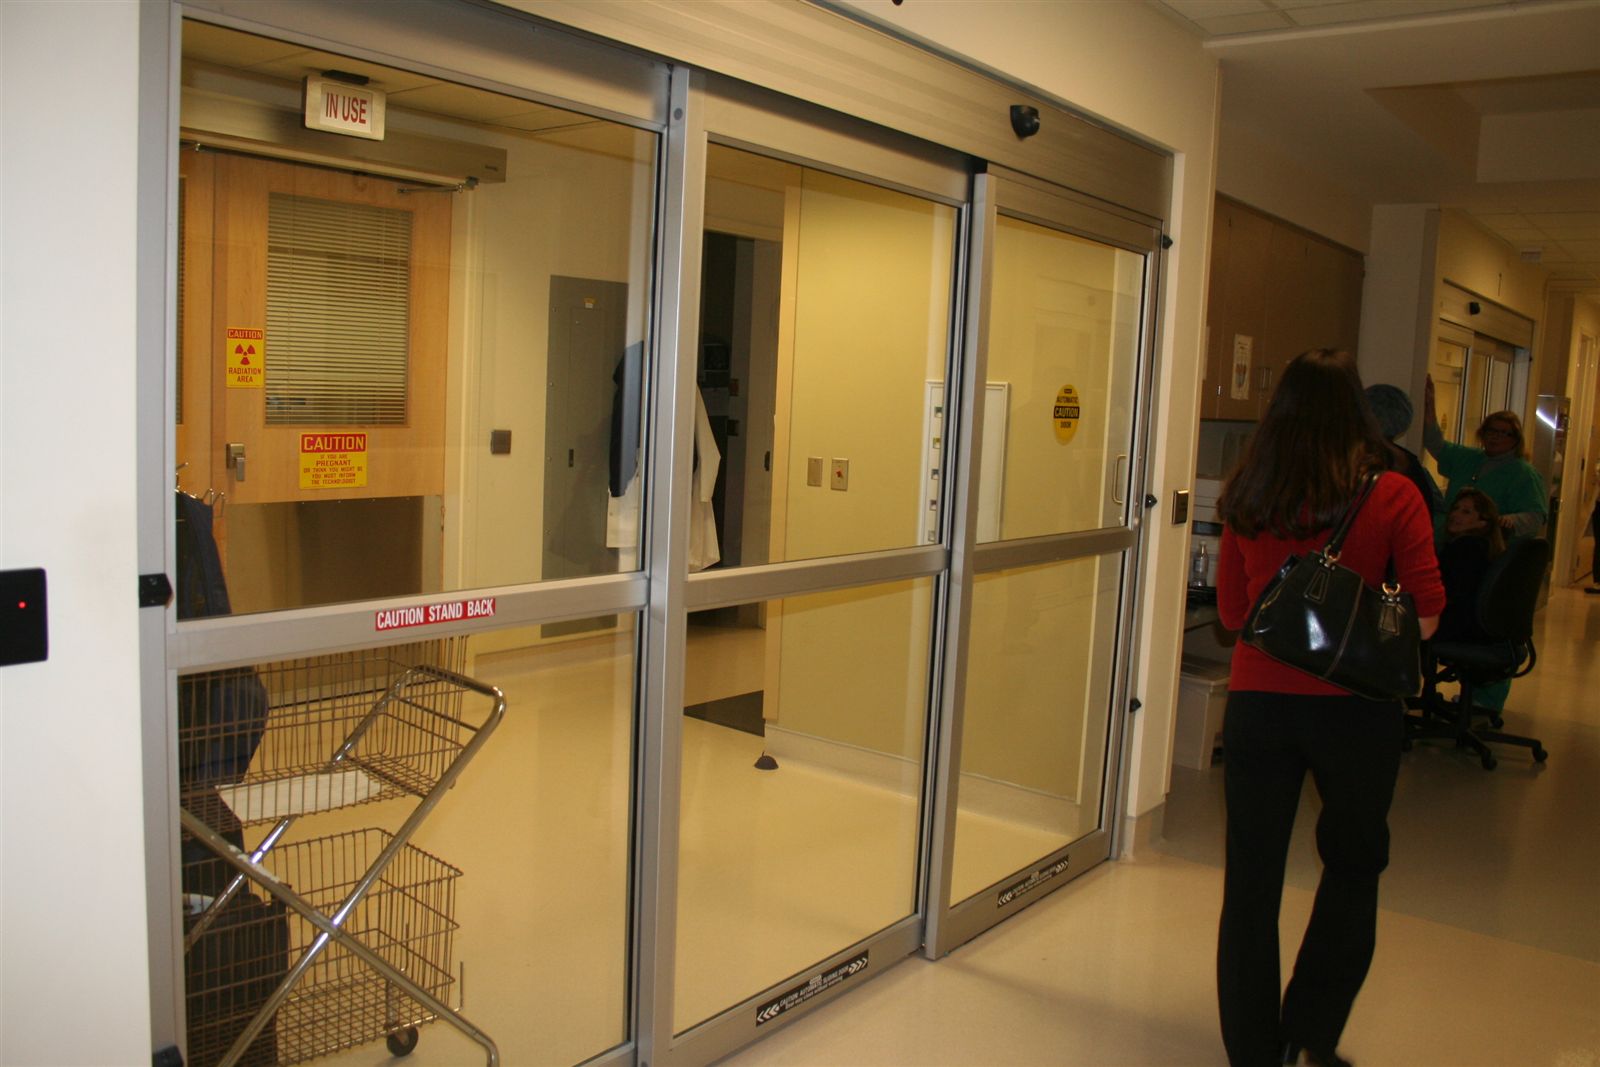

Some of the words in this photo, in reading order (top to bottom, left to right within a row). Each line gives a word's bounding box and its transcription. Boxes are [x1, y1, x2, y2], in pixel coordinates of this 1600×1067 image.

[325, 92, 339, 119] IN
[342, 96, 368, 124] USE
[228, 329, 262, 338] CAUTION
[228, 367, 261, 375] RADIATION
[237, 375, 253, 383] AREA
[1055, 407, 1078, 417] CAUTION
[303, 436, 364, 451] CAUTION
[377, 607, 424, 629] CAUTION
[428, 602, 463, 622] STAND
[467, 598, 495, 617] BACK
